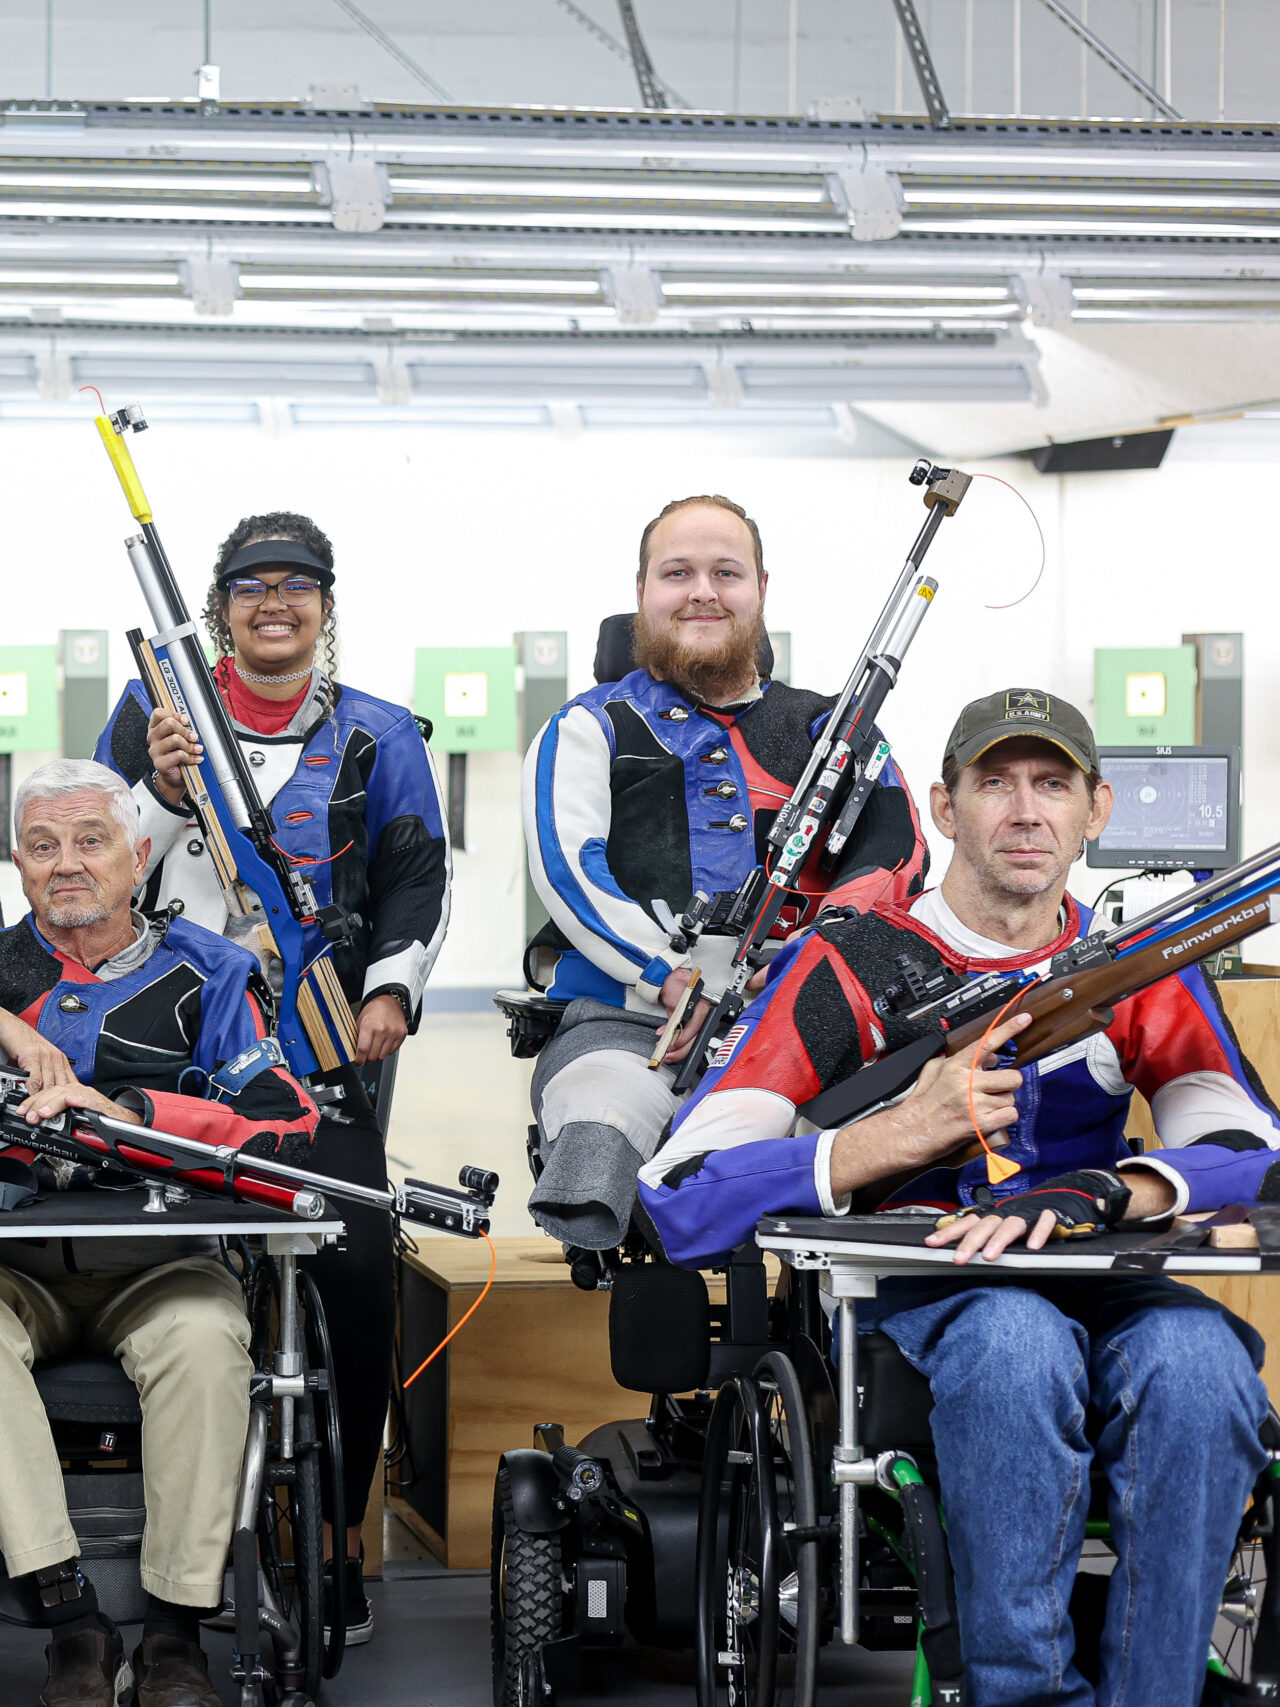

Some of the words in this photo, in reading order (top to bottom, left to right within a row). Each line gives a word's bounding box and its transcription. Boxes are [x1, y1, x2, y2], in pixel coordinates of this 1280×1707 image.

[161, 661, 171, 674] LG
[167, 676, 179, 695] 300
[776, 803, 793, 823] 9015
[1199, 805, 1223, 818] 10.5
[1073, 936, 1099, 954] 9015
[726, 1558, 736, 1707] SPNERGY
[940, 1689, 960, 1703] Ti
